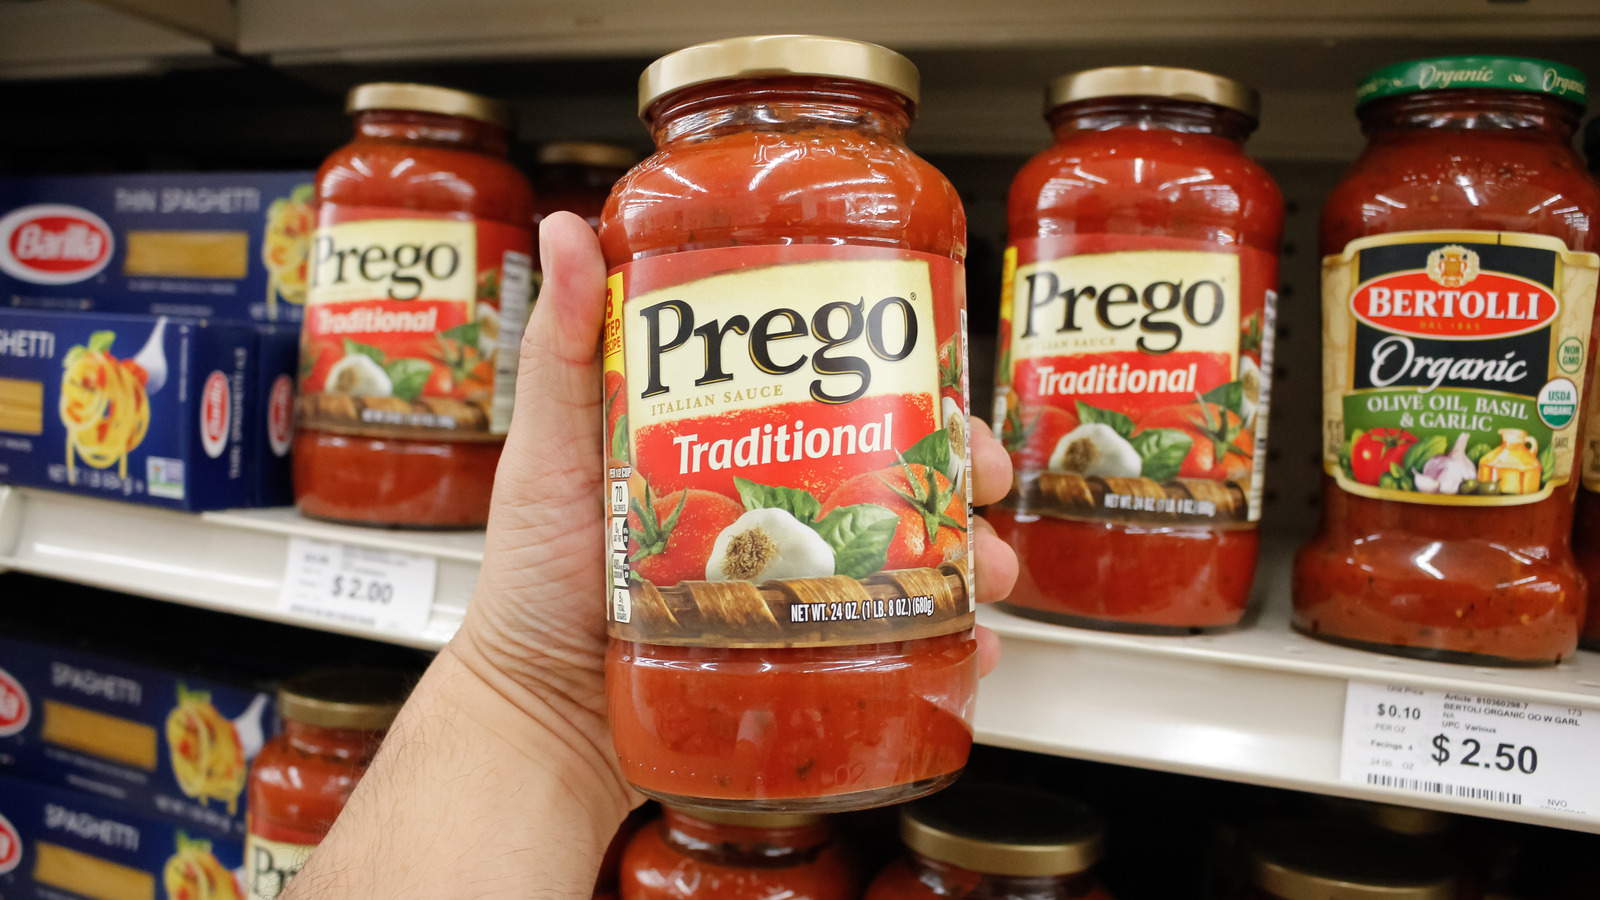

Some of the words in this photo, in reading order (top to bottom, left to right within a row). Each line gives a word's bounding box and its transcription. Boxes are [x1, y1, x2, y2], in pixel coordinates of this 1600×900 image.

[1419, 66, 1493, 89] Organic
[115, 188, 155, 213] THIN
[161, 188, 259, 213] SPAGHETTI
[17, 223, 101, 261] Barilla
[312, 234, 460, 301] Prego
[1021, 271, 1225, 355] Prego
[1367, 286, 1540, 321] BERTOLLI
[318, 306, 438, 335] Traditional
[640, 295, 918, 405] Prego
[1074, 337, 1116, 347] SAUCE
[1564, 345, 1580, 355] NON
[1369, 335, 1528, 394] Organic
[1562, 356, 1580, 365] GMO
[1036, 363, 1198, 396] Traditional
[651, 394, 715, 417] ITALIAN
[723, 384, 783, 404] SAUCE
[1367, 395, 1425, 413] OLIVE
[1429, 395, 1468, 414] OIL,
[1475, 397, 1529, 420] BASIL
[1548, 391, 1571, 401] USDA
[1400, 412, 1414, 428] &
[1419, 412, 1493, 432] GARLIC
[1543, 405, 1573, 416] ORGANIC
[673, 412, 893, 475] Traditional
[1554, 436, 1569, 449] SAUCE
[615, 485, 623, 502] 70
[790, 604, 809, 622] NET
[811, 603, 829, 622] WT.
[831, 602, 842, 621] 24
[845, 601, 860, 620] OZ.
[861, 600, 871, 620] (1
[873, 600, 887, 618] LB.
[888, 600, 894, 617] 8
[896, 598, 911, 617] OZ.)
[912, 595, 935, 617] (680g)
[52, 661, 142, 706] SPAGHETTI
[1405, 686, 1424, 695] Price
[1443, 711, 1455, 719] NA
[1444, 703, 1482, 714] BERTOLI
[1484, 707, 1525, 720] ORGANIC
[1543, 715, 1553, 723] W
[1555, 716, 1580, 727] GARL
[1445, 693, 1471, 703] Article
[1567, 708, 1582, 717] 173
[1375, 723, 1393, 732] PER
[1442, 720, 1459, 729] UPC
[1465, 722, 1497, 734] Various
[1370, 739, 1402, 751] Facings
[1402, 762, 1414, 770] OZ
[1547, 798, 1567, 807] NVO
[45, 803, 140, 851] SPAGHETTI
